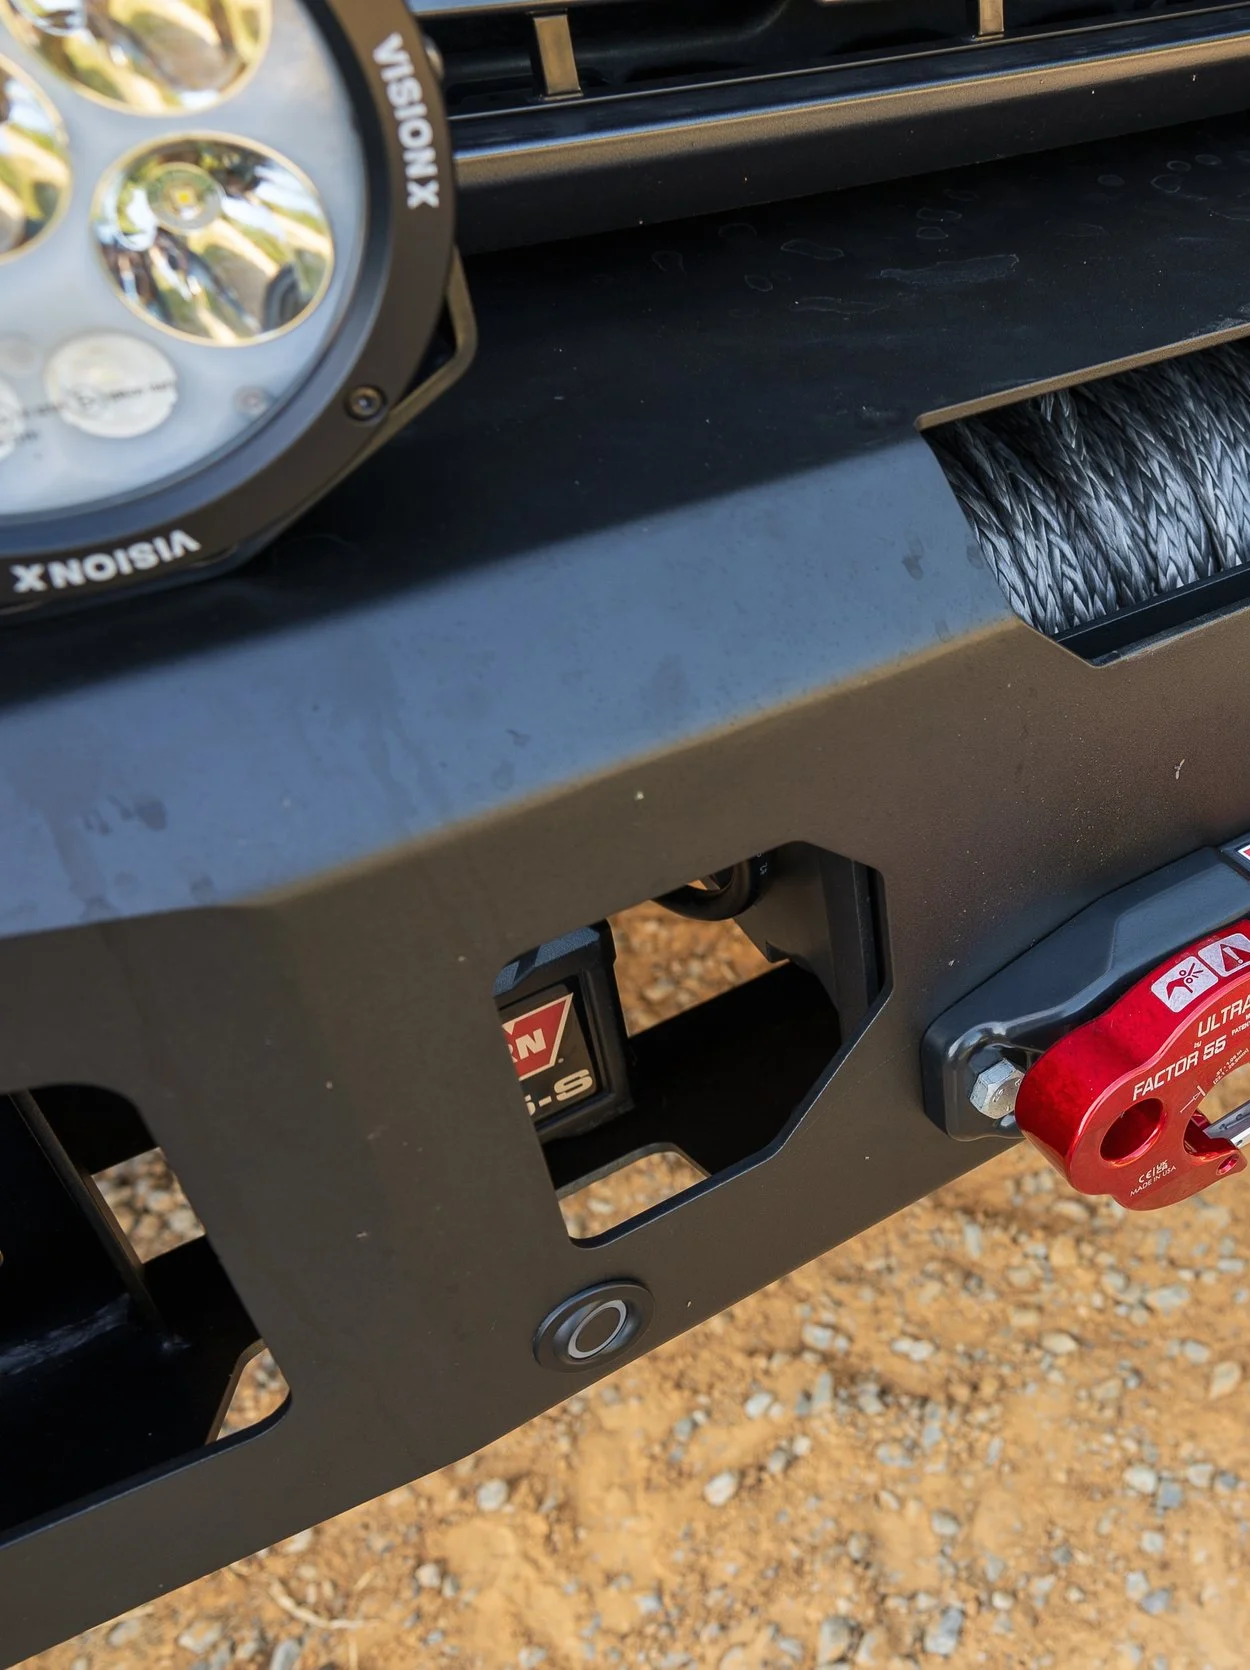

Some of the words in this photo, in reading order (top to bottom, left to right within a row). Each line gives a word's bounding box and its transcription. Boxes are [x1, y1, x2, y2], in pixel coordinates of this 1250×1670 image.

[372, 31, 439, 179] VISION
[406, 179, 440, 209] X
[9, 563, 48, 593] X
[48, 529, 202, 589] VISION
[1132, 1050, 1199, 1101] FACTOR
[1202, 1034, 1227, 1061] 55
[1130, 1179, 1152, 1197] MADE
[1153, 1174, 1161, 1182] IN
[1162, 1165, 1177, 1177] USA
